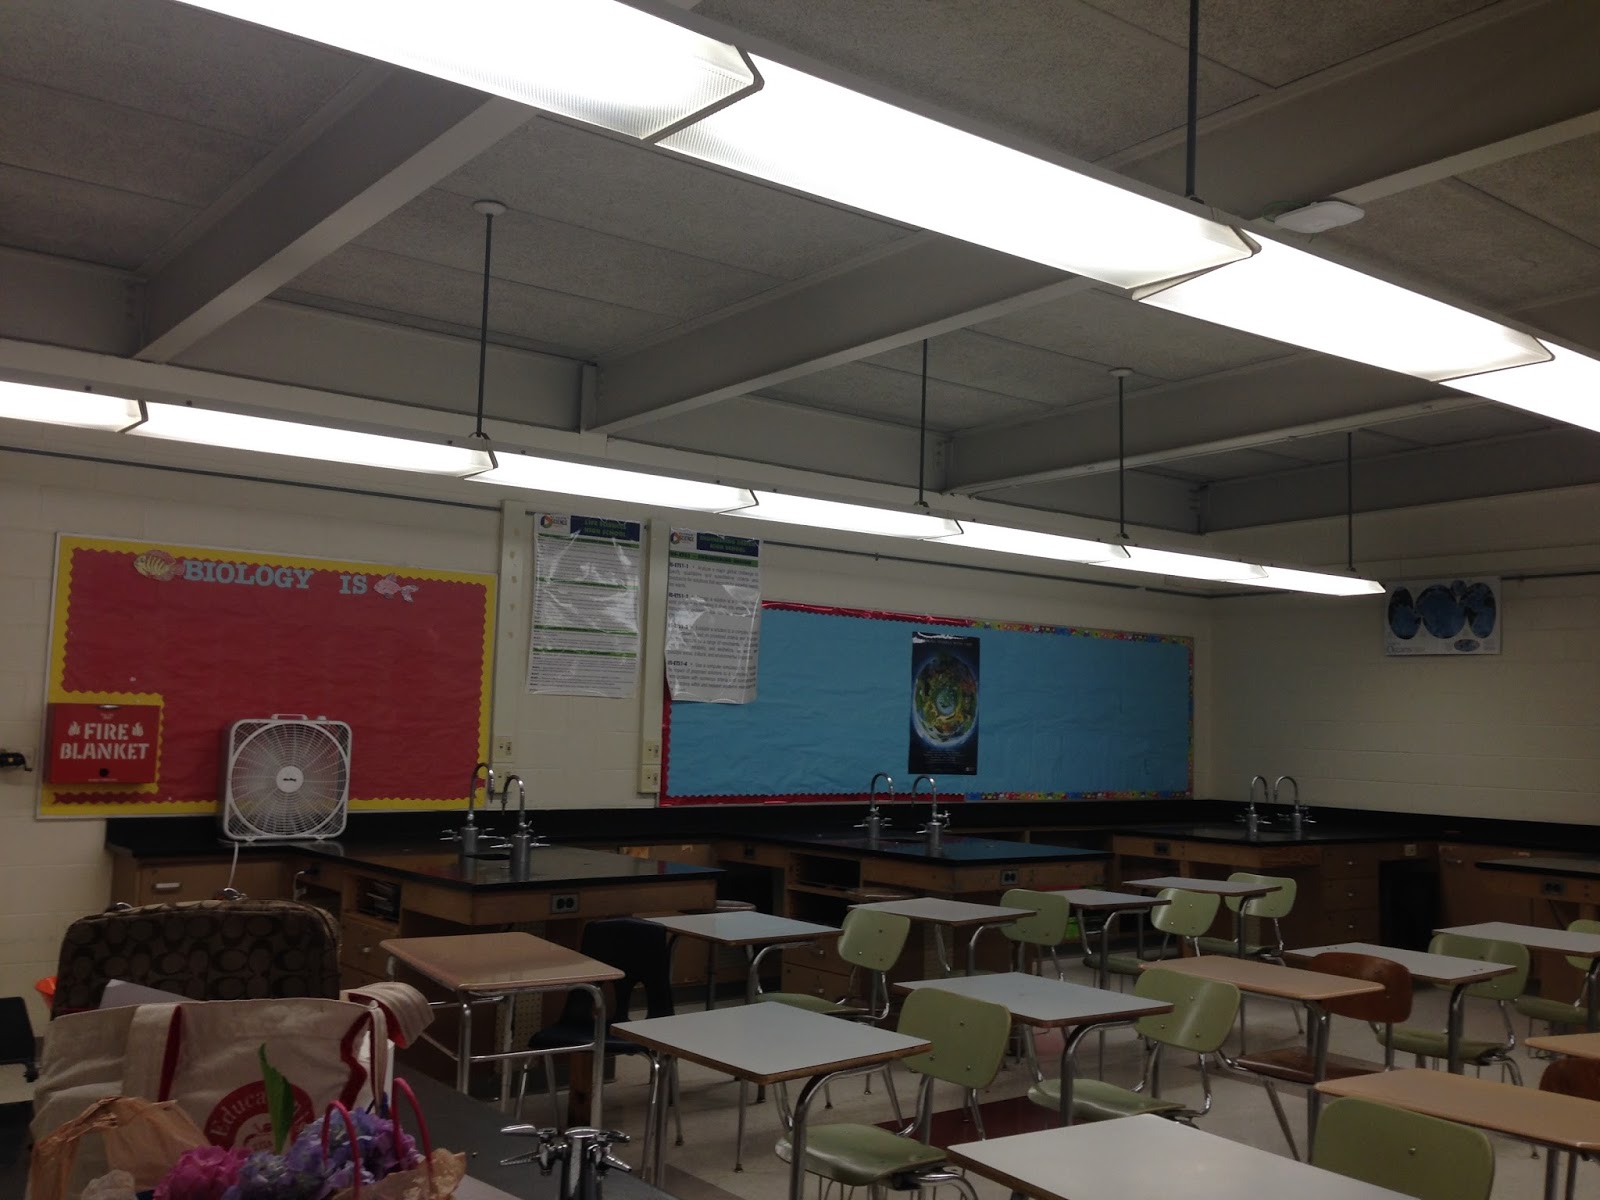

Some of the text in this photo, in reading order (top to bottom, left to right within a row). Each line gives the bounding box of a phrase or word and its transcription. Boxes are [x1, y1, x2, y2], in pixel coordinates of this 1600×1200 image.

[183, 560, 368, 595] BIOLOGY IS
[83, 722, 129, 741] FIRE
[59, 742, 150, 760] BLANKET
